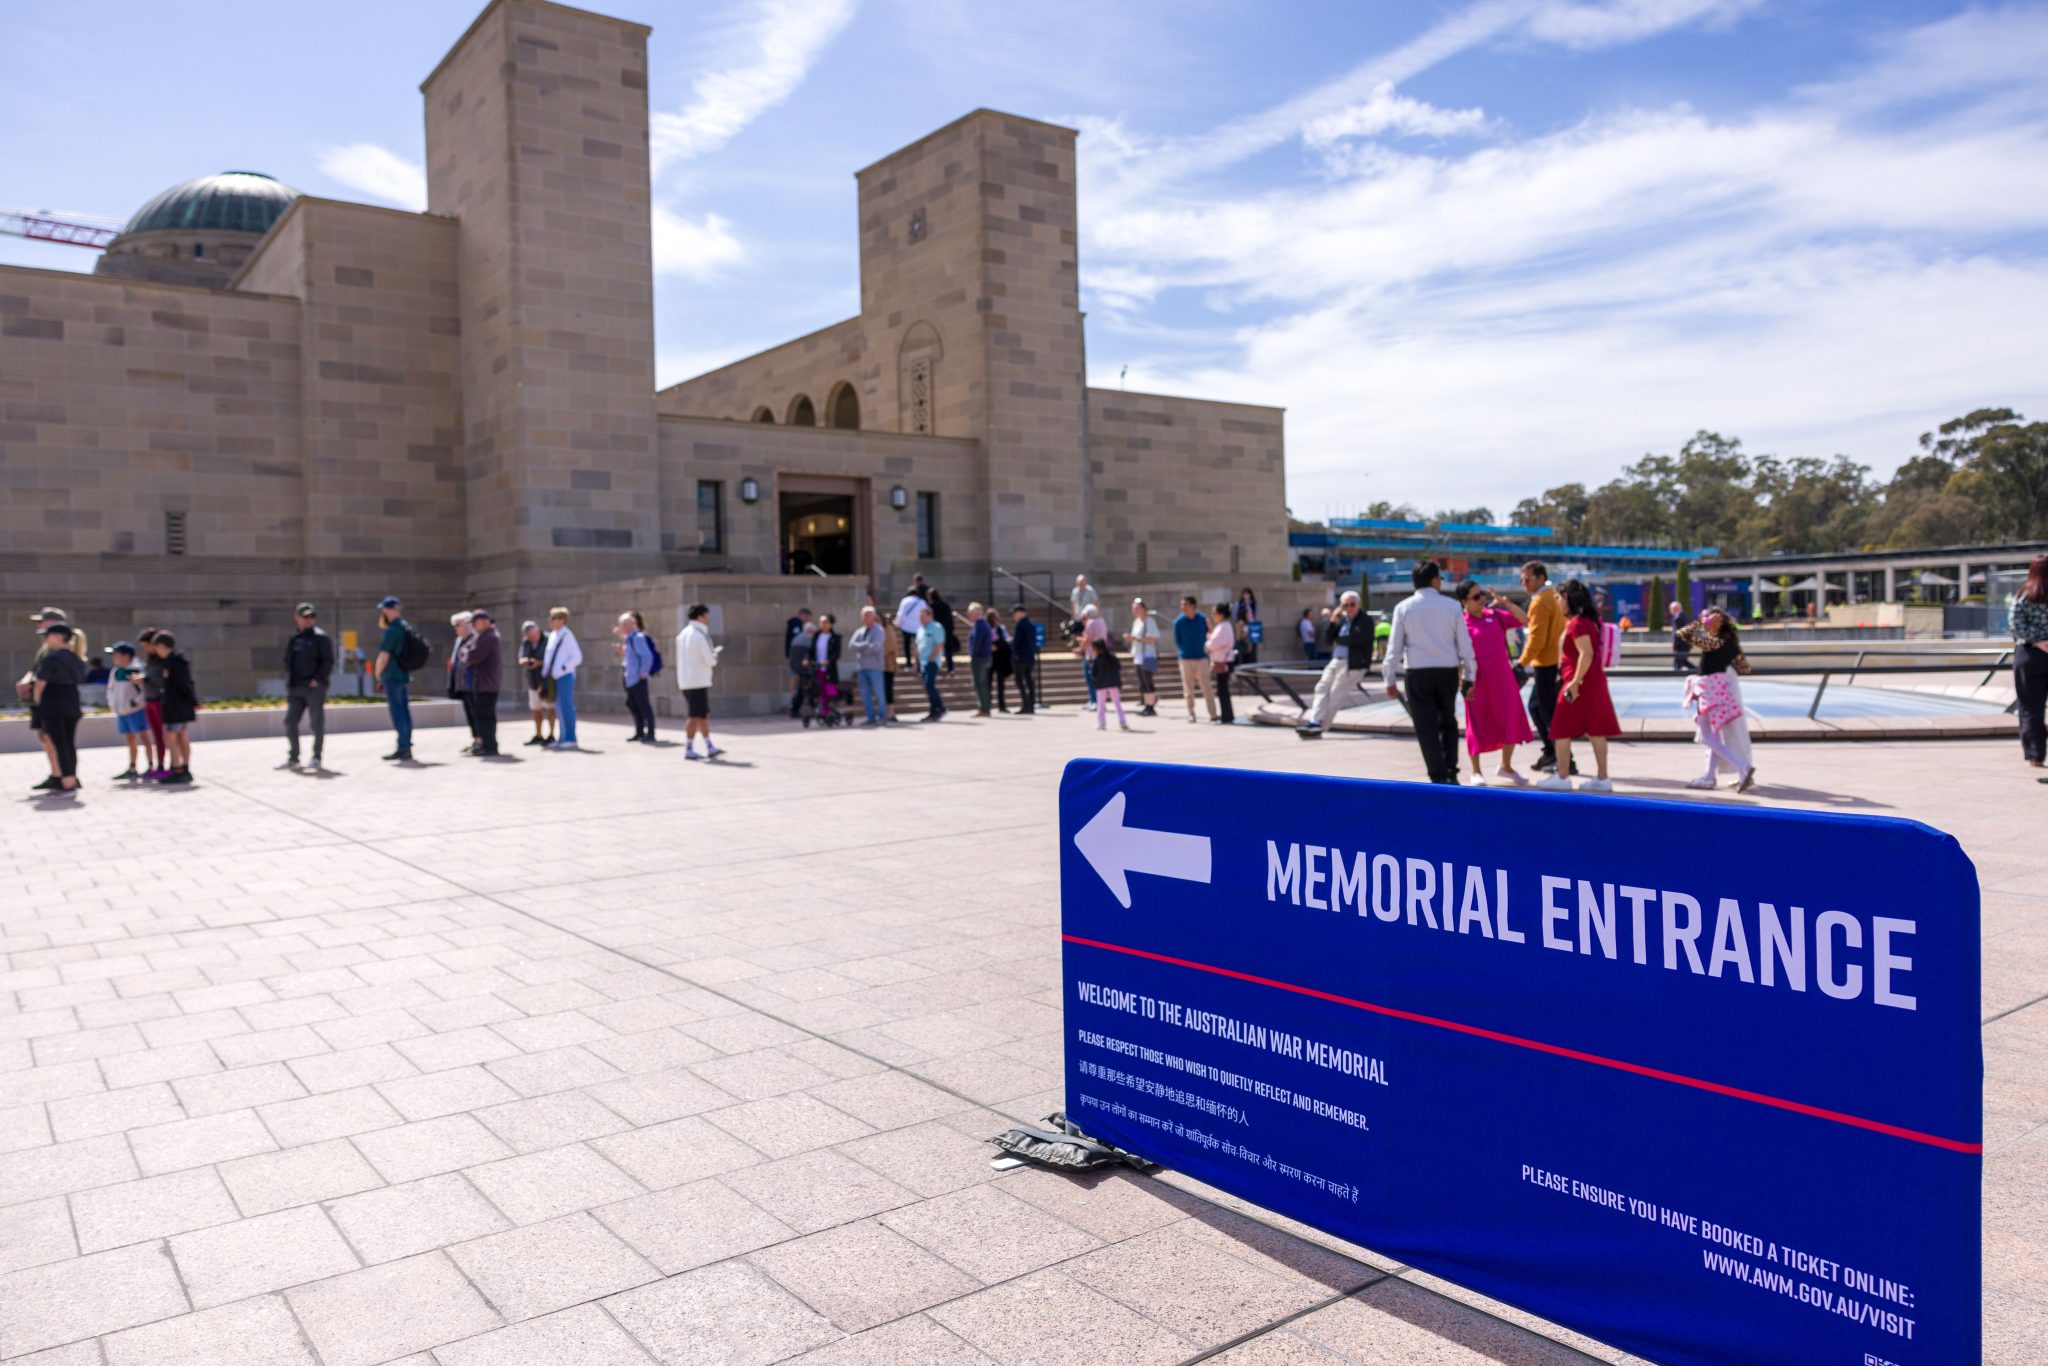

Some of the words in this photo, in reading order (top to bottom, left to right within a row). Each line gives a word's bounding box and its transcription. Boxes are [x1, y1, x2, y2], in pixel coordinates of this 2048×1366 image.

[1266, 839, 1526, 944] MEMORIAL
[1540, 874, 1917, 1011] ENTRANCE
[1077, 980, 1138, 1015] WELCOME
[1139, 995, 1156, 1020] TO
[1157, 1000, 1183, 1027] THE
[1184, 1007, 1267, 1050] AUSTRALIAN
[1269, 1029, 1303, 1061] WAR
[1306, 1039, 1389, 1087] MEMORIAL
[1079, 1030, 1105, 1048] PLEASE
[1106, 1037, 1138, 1057] RESPECT
[1139, 1047, 1164, 1065] THOSE
[1165, 1054, 1184, 1071] WHO
[1185, 1060, 1206, 1078] WISH
[1208, 1067, 1218, 1081] TO
[1220, 1071, 1253, 1092] QUIETLY
[1255, 1081, 1291, 1104] REFLECT
[1293, 1093, 1311, 1111] AND
[1314, 1100, 1369, 1131] REMEMBER.
[1078, 1059, 1250, 1128] 请尊重那些希望安静地追思和缅怀的人
[1080, 1094, 1098, 1107] कृपया
[1100, 1101, 1110, 1112] उन
[1111, 1102, 1127, 1117] लोगों
[1128, 1109, 1138, 1121] का
[1139, 1113, 1160, 1129] सम्मान
[1161, 1120, 1173, 1134] करें
[1175, 1123, 1184, 1137] जो
[1186, 1129, 1220, 1149] शांतिपूर्वक
[1221, 1140, 1260, 1165] सोच-विचार
[1262, 1154, 1277, 1172] और
[1279, 1162, 1301, 1181] स्मरण
[1303, 1171, 1325, 1190] करना
[1327, 1180, 1349, 1199] चाहते
[1351, 1185, 1359, 1204] हैं
[1522, 1164, 1569, 1194] PLEASE
[1572, 1179, 1626, 1213] ENSURE
[1628, 1196, 1657, 1222] YOU
[1660, 1207, 1698, 1236] HAVE
[1701, 1220, 1764, 1257] BOOKED
[1766, 1242, 1778, 1263] A
[1781, 1245, 1841, 1283] TICKET
[1843, 1266, 1915, 1309] ONLINE:
[1703, 1249, 1916, 1340] WWW.AWM.GOV.AU/VISIT
